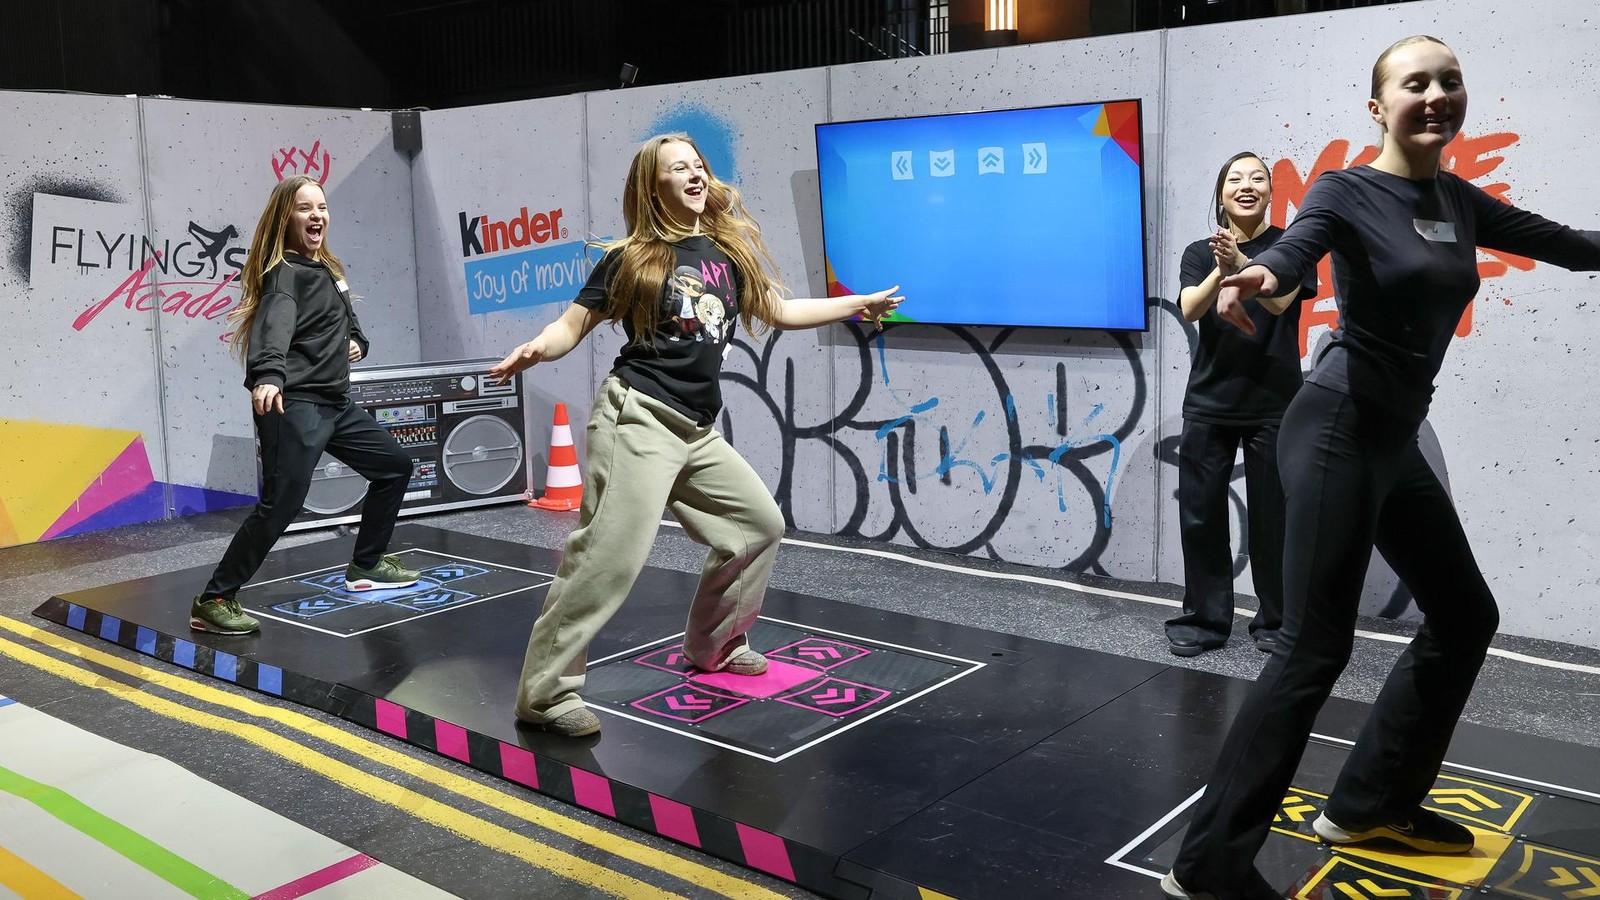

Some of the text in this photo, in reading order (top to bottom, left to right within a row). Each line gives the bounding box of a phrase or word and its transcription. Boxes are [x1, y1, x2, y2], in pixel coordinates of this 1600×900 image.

[51, 226, 206, 277] FLYING
[473, 270, 506, 303] Joy
[511, 260, 530, 295] of
